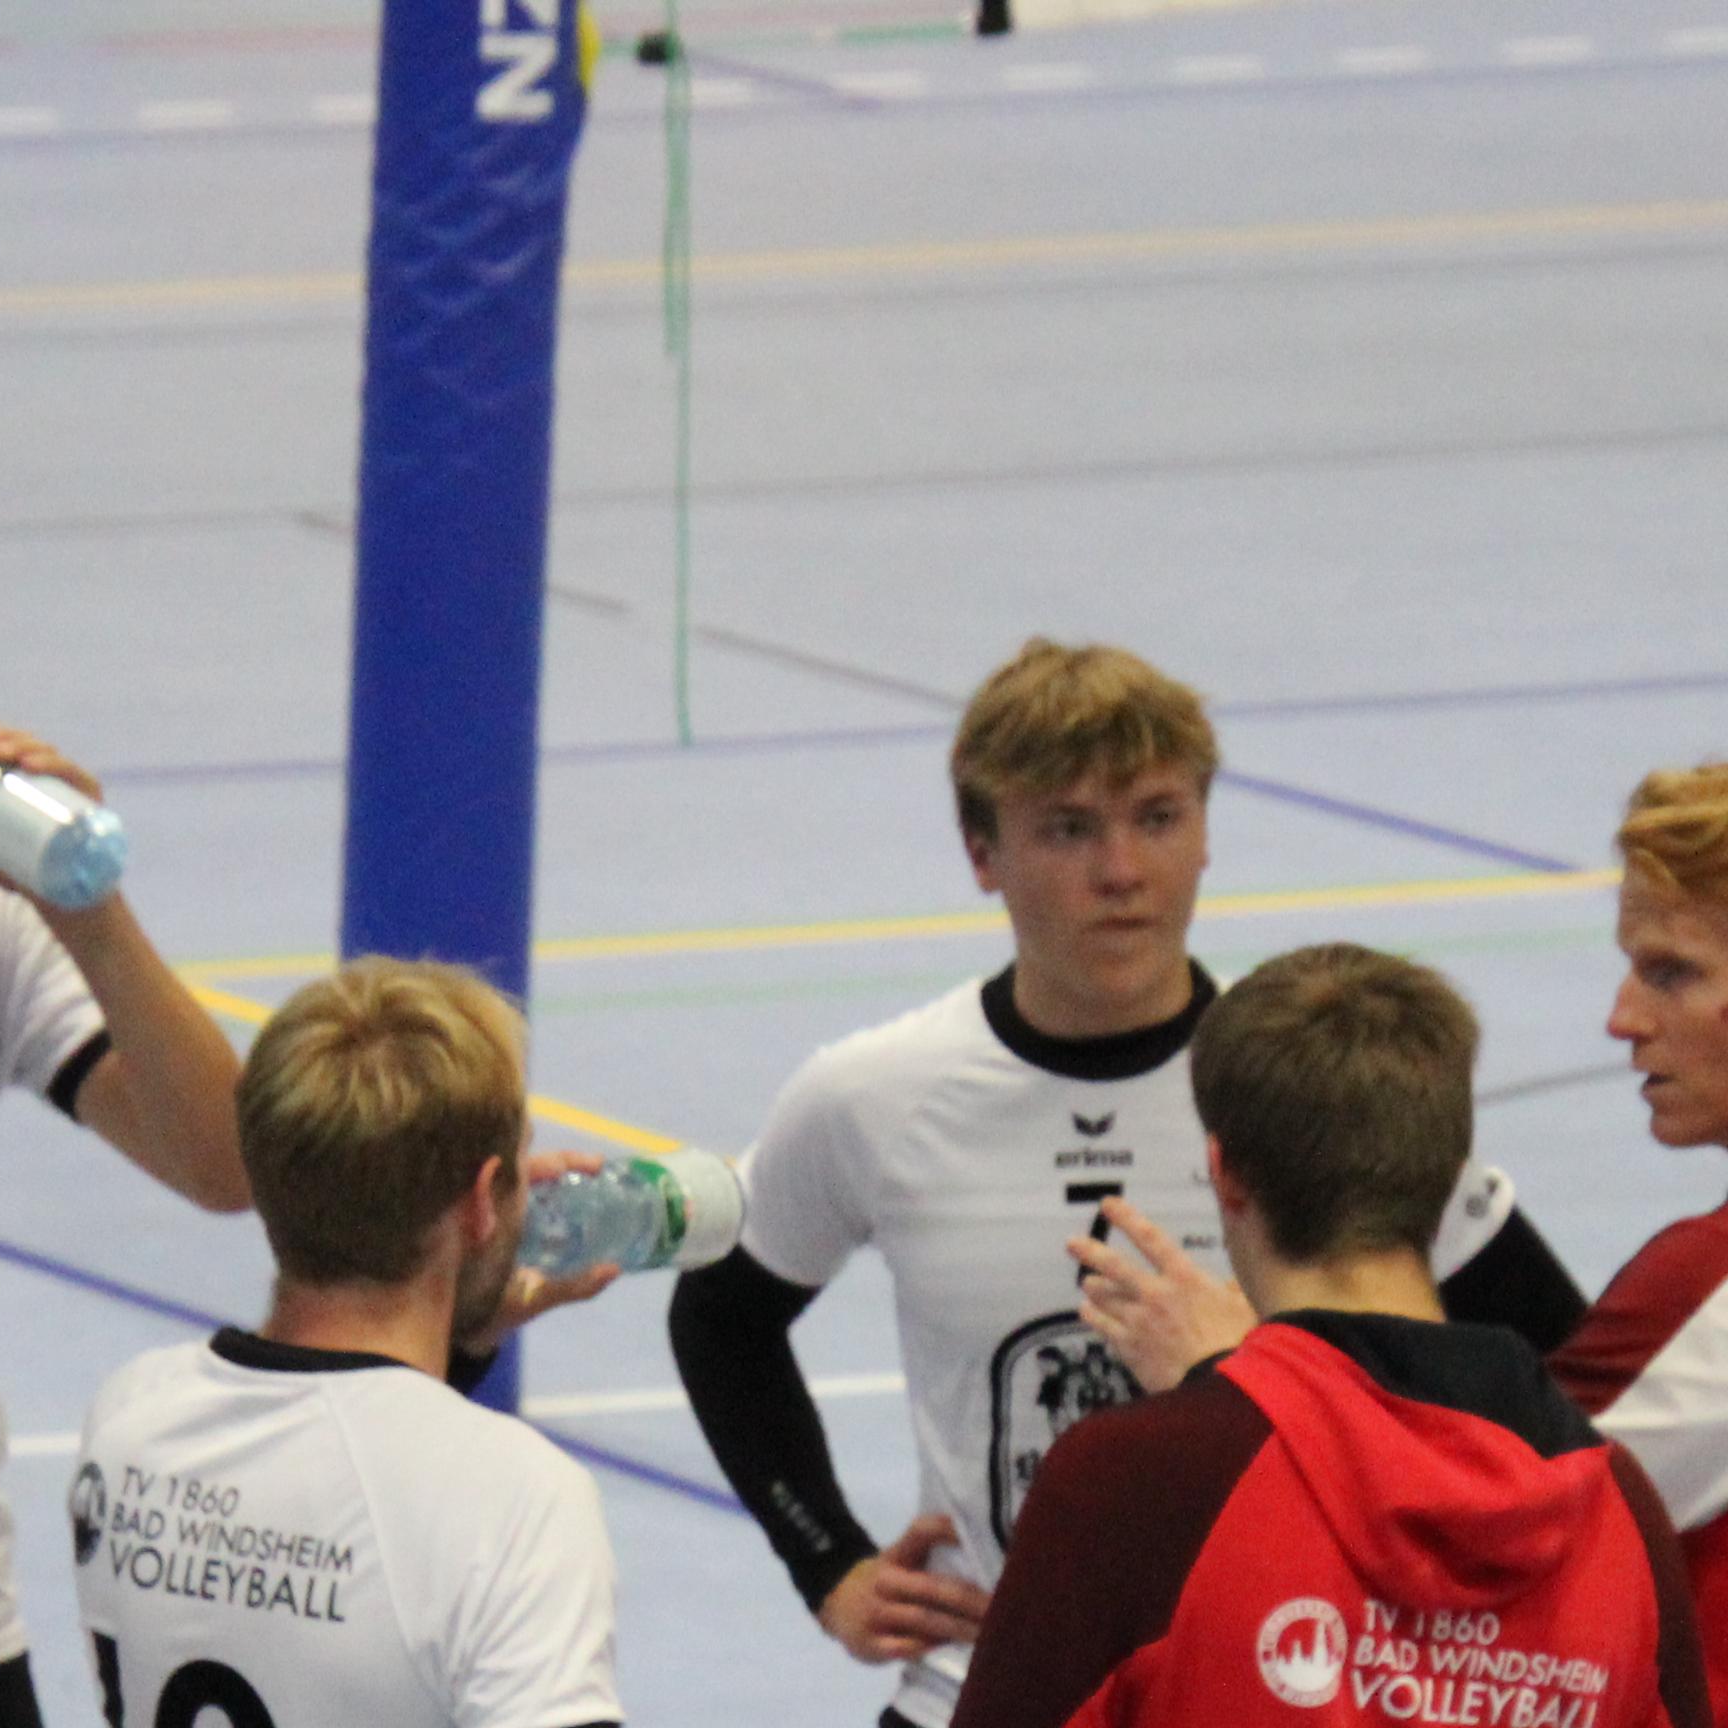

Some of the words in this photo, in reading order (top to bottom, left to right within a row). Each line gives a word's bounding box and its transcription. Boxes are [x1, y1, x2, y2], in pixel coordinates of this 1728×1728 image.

[122, 1466, 156, 1497] TV
[166, 1475, 241, 1518] 1860
[111, 1501, 166, 1541] BAD
[178, 1515, 355, 1577] WINDSHEIM
[109, 1537, 346, 1623] VOLLEYBALL
[1363, 1599, 1399, 1633] TV
[1414, 1608, 1502, 1646] 1860
[1353, 1634, 1420, 1673] BAD
